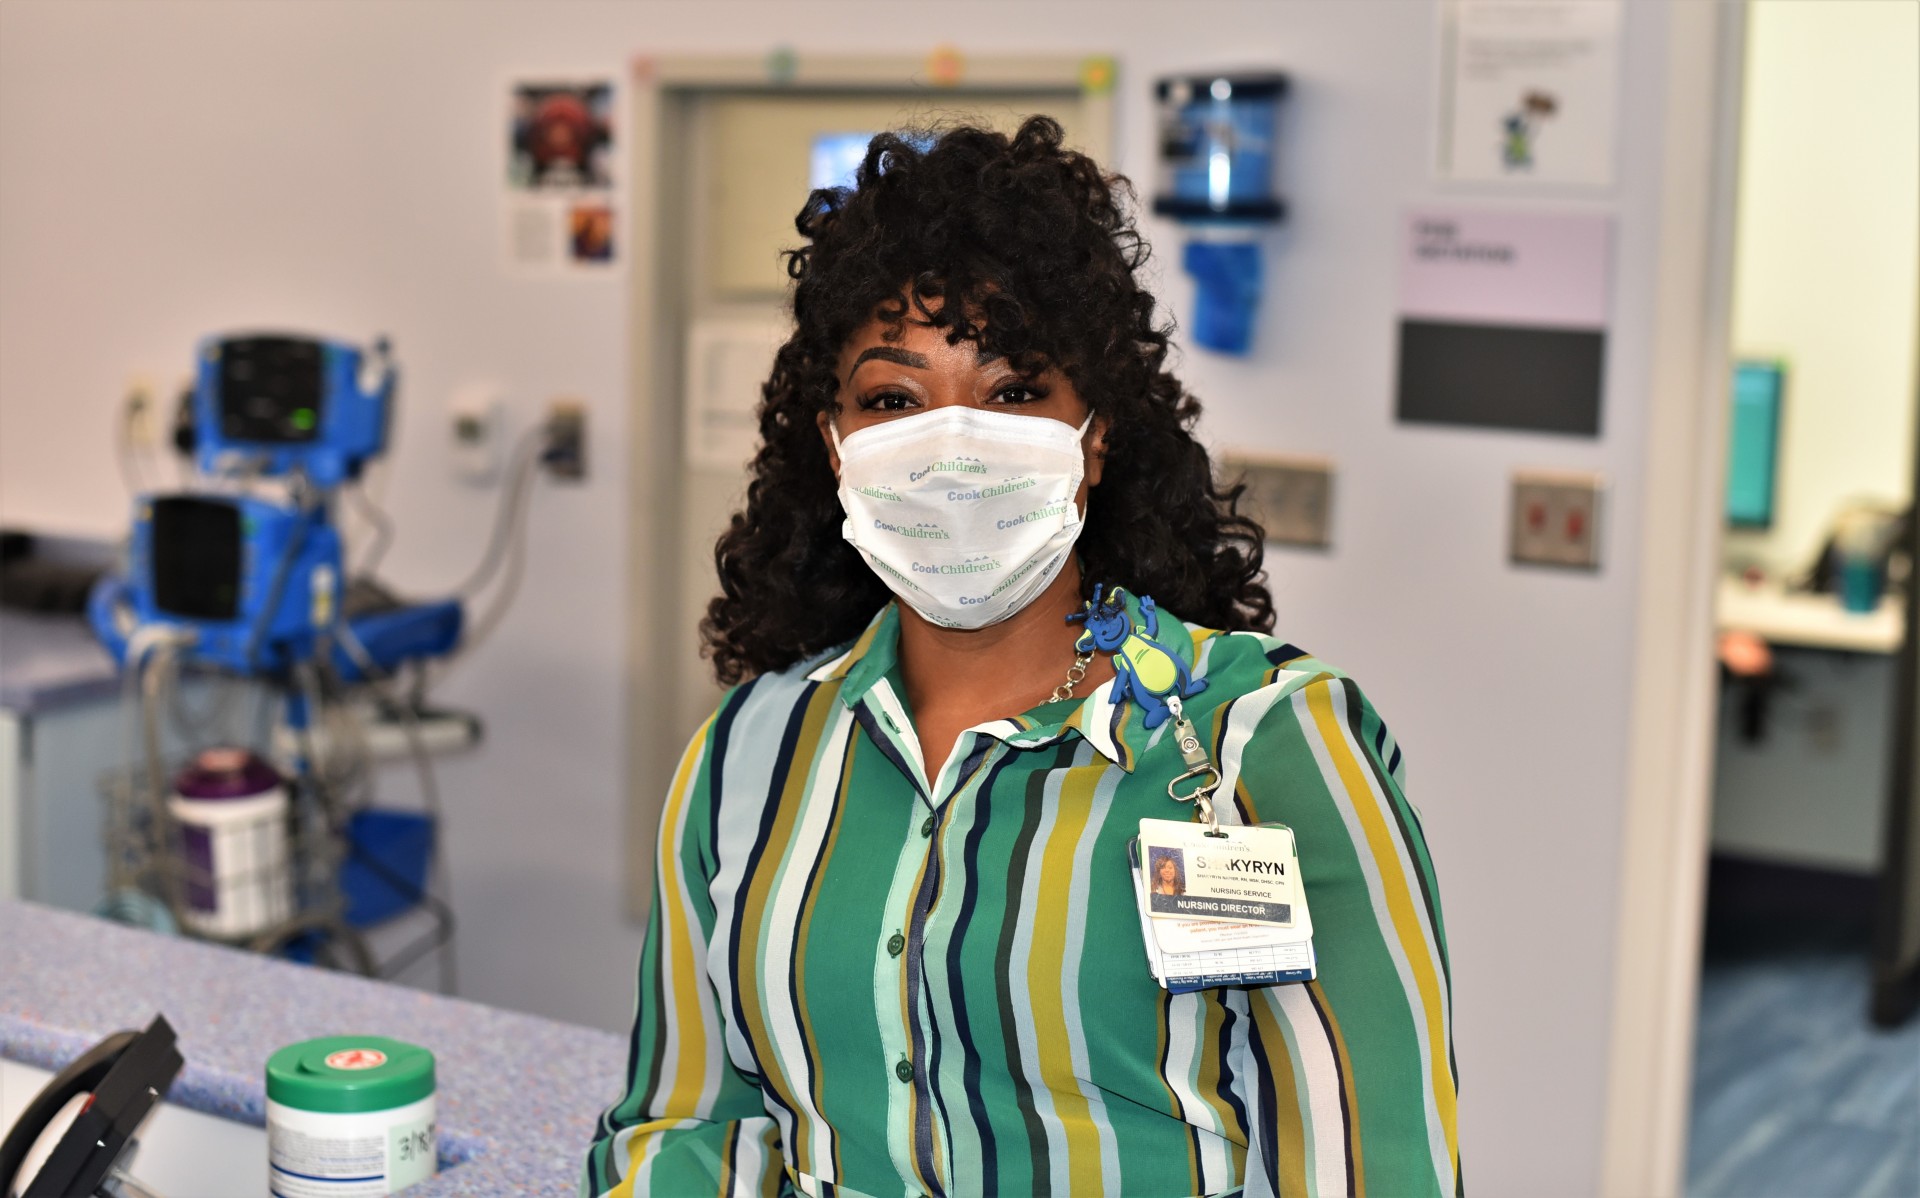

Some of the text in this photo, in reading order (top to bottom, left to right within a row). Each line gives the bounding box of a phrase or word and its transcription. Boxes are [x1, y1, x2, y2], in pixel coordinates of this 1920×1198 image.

[1196, 856, 1285, 876] SKYRYN
[1210, 887, 1272, 899] NURSING SERVICE
[1177, 900, 1266, 915] NURSING DIRECTOR
